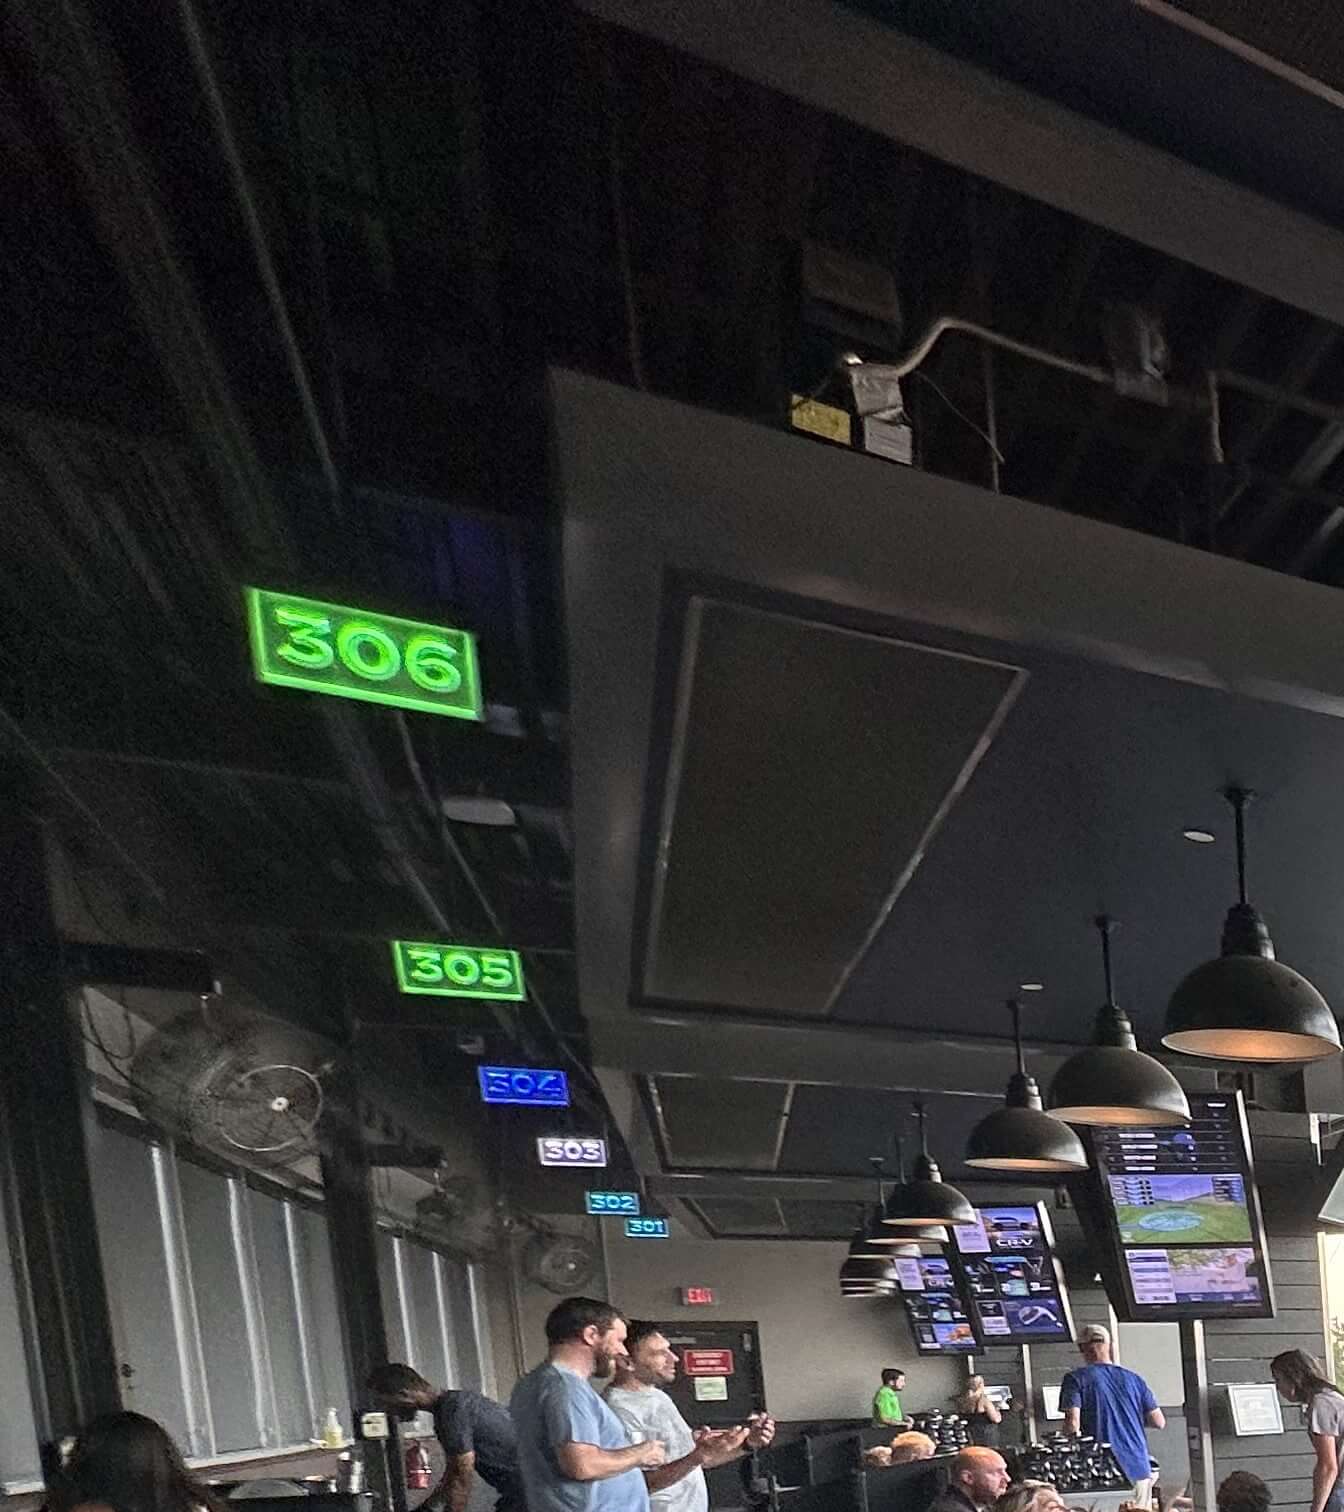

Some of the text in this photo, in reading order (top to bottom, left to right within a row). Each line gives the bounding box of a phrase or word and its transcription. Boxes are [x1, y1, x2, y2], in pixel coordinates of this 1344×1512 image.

[275, 605, 462, 693] 306
[408, 948, 513, 989] 305
[485, 1071, 562, 1096] 304
[542, 1140, 602, 1162] 303
[589, 1193, 637, 1211] 302
[626, 1218, 666, 1234] 301
[996, 1238, 1034, 1247] CR-V
[687, 1287, 712, 1303] EXIT
